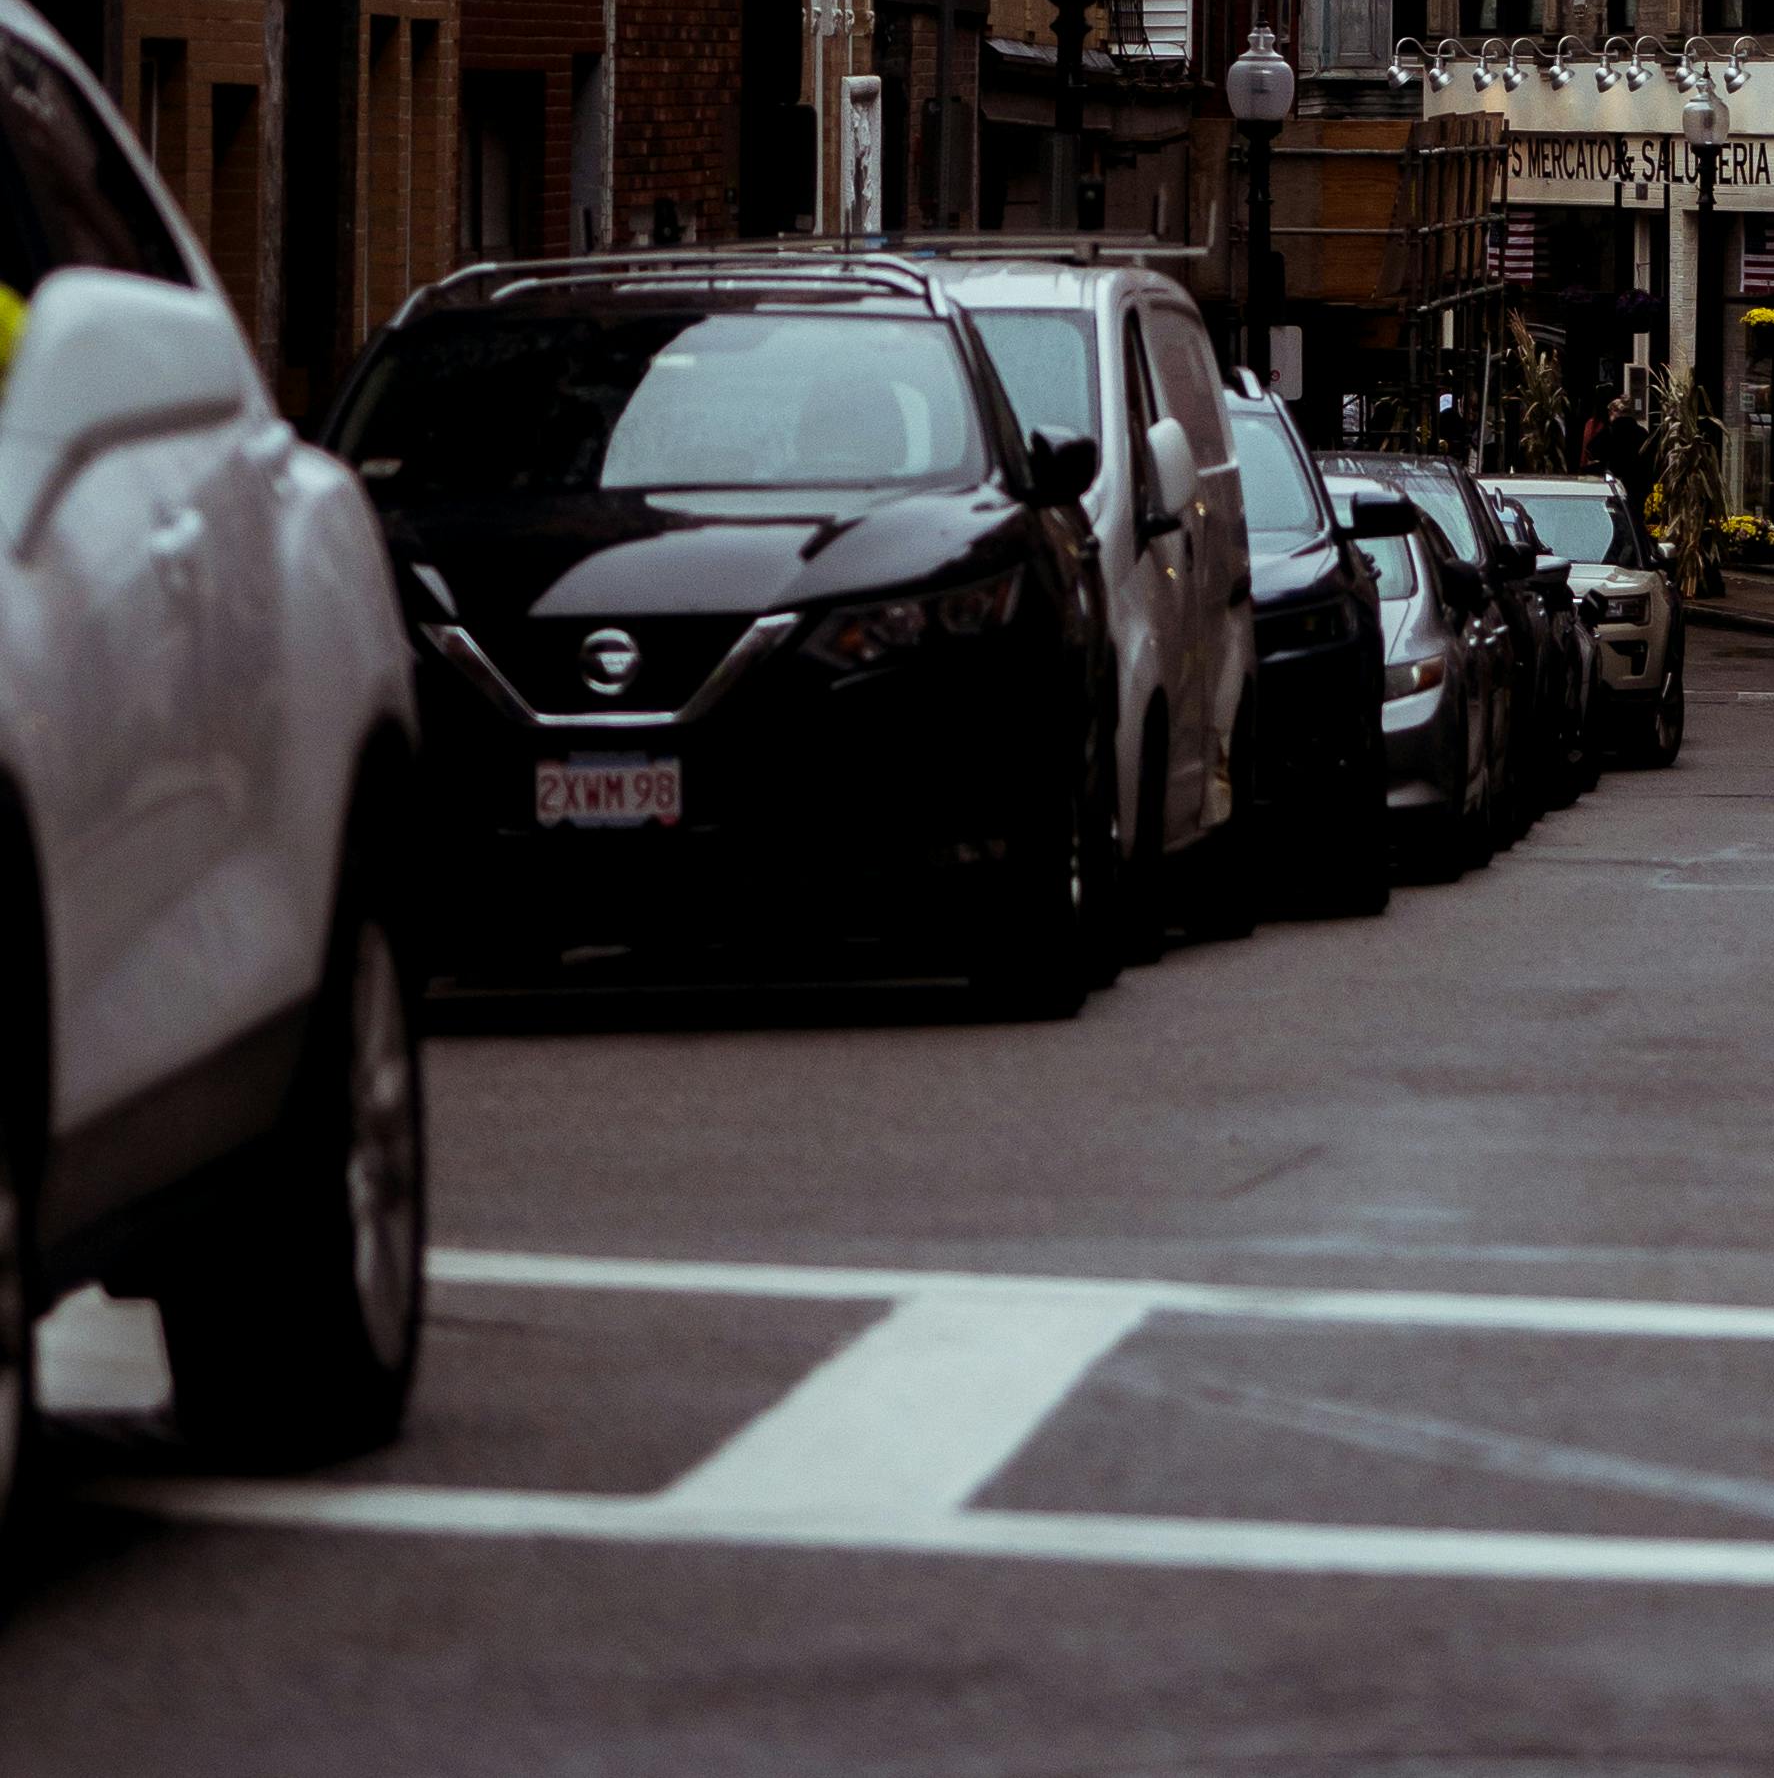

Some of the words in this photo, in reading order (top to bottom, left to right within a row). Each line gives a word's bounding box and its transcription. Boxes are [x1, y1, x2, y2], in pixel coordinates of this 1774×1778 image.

[1527, 137, 1613, 181] MERCATO
[1615, 139, 1635, 182] &
[1641, 139, 1771, 185] SALUERIA
[540, 774, 625, 813] 2XWM
[633, 773, 676, 809] 98
